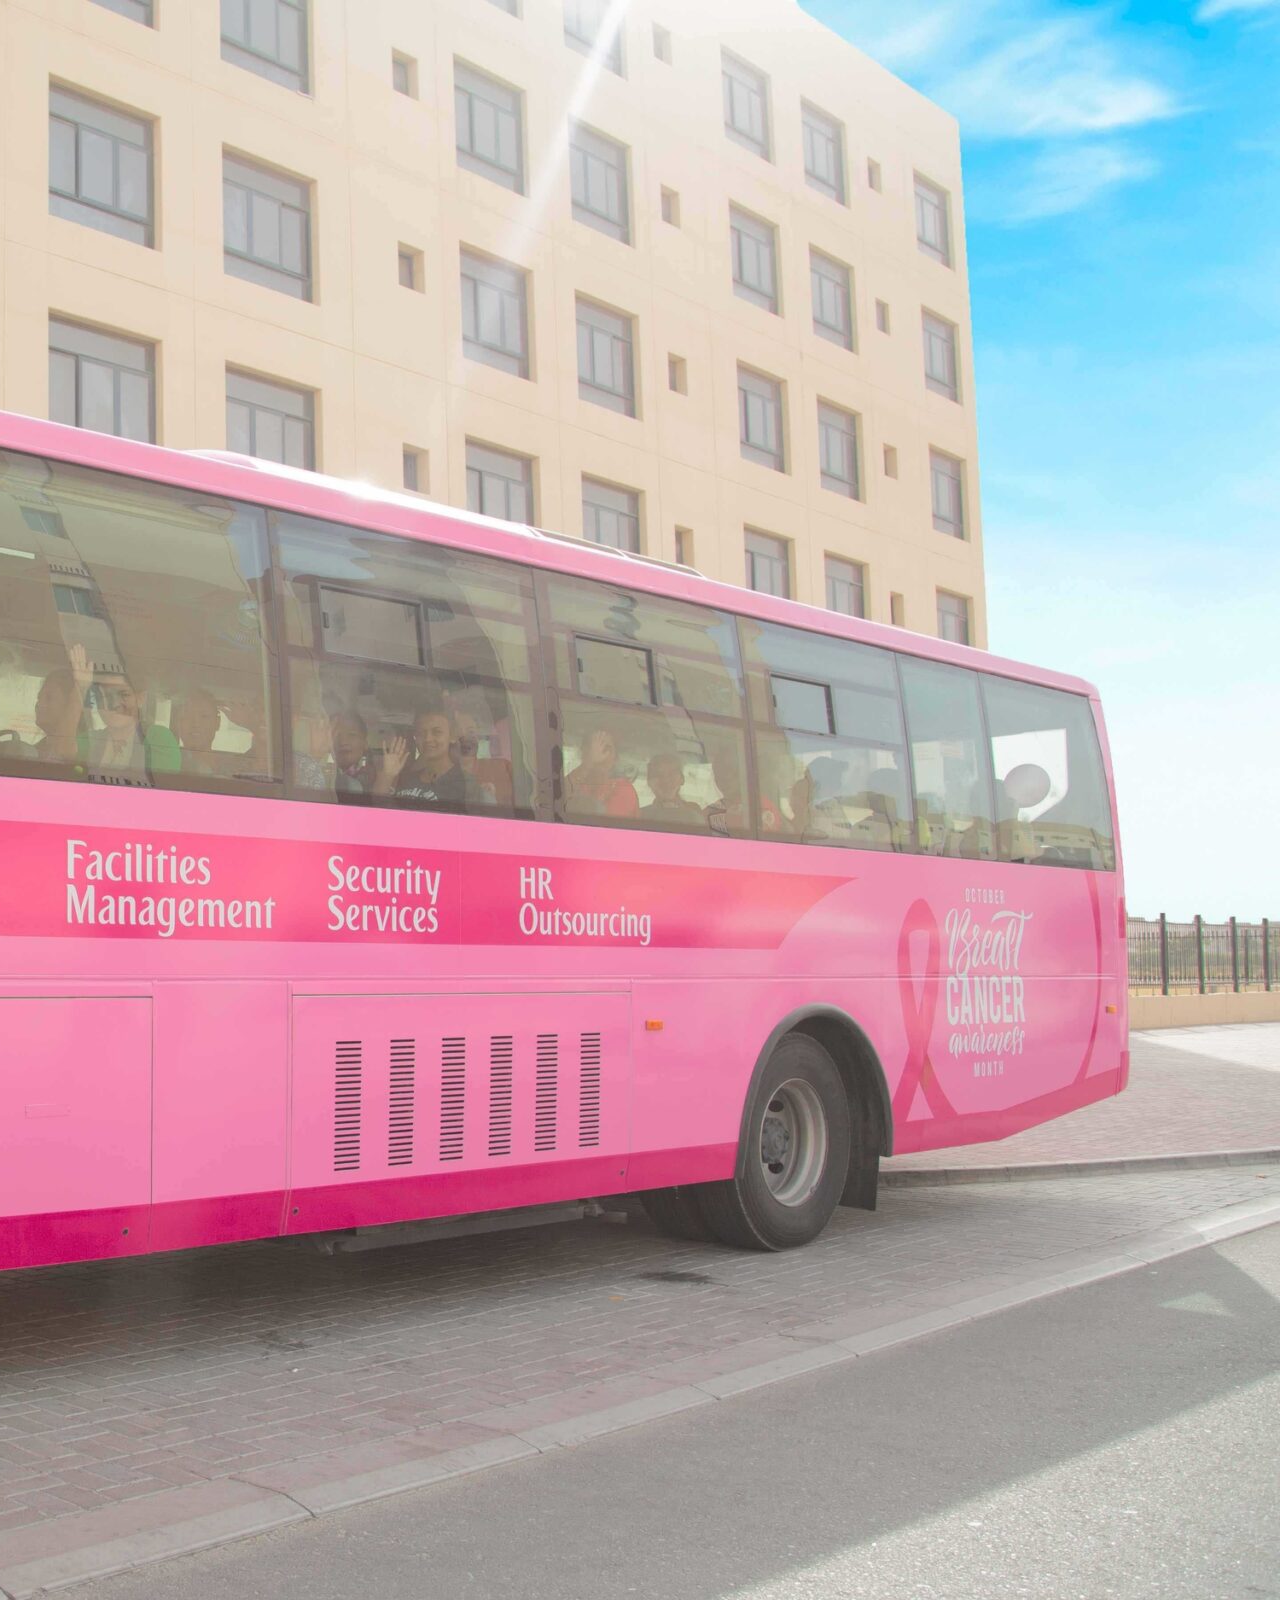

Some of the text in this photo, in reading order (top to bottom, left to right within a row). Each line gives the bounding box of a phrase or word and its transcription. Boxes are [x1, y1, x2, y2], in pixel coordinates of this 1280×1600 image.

[66, 839, 211, 885] Facilities
[327, 855, 442, 905] Security
[519, 866, 554, 900] HR
[66, 884, 276, 938] Management
[327, 894, 439, 933] Services
[965, 887, 1005, 905] OCTOBER
[519, 902, 651, 946] Outsourcing
[945, 908, 1034, 979] Breast
[946, 974, 1026, 1025] CANCER
[948, 1021, 1026, 1058] awareness
[973, 1060, 1004, 1077] MONTH
